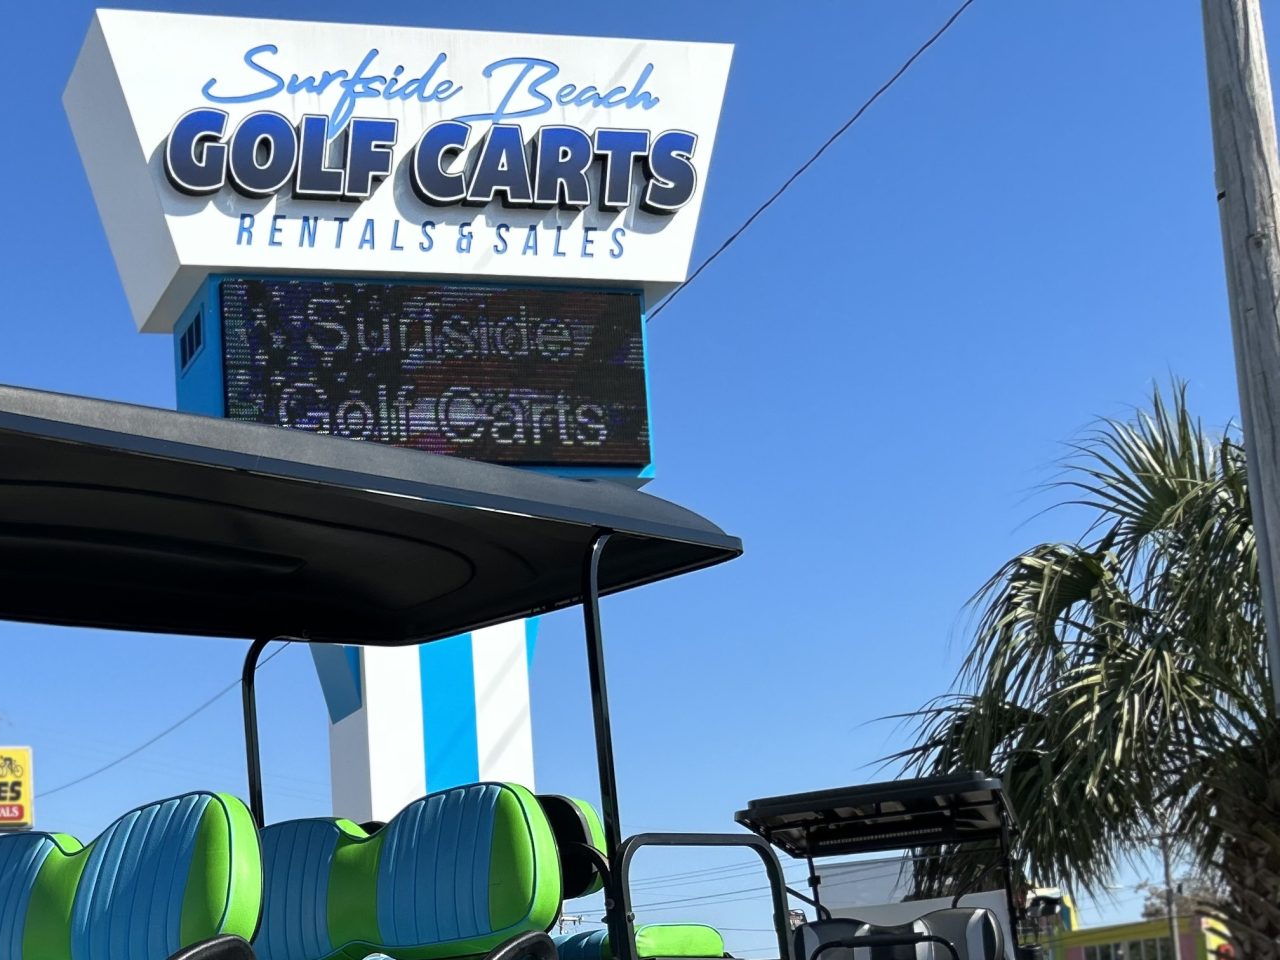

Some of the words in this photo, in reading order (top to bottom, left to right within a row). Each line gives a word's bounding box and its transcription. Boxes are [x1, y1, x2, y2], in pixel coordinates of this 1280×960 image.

[201, 44, 463, 139] Surfside
[451, 57, 660, 124] Beach
[165, 108, 399, 200] GOLF
[414, 120, 698, 214] CARTS
[236, 213, 436, 253] RENTALS
[456, 221, 474, 254] &
[493, 224, 627, 259] SALES
[438, 386, 608, 445] Carts
